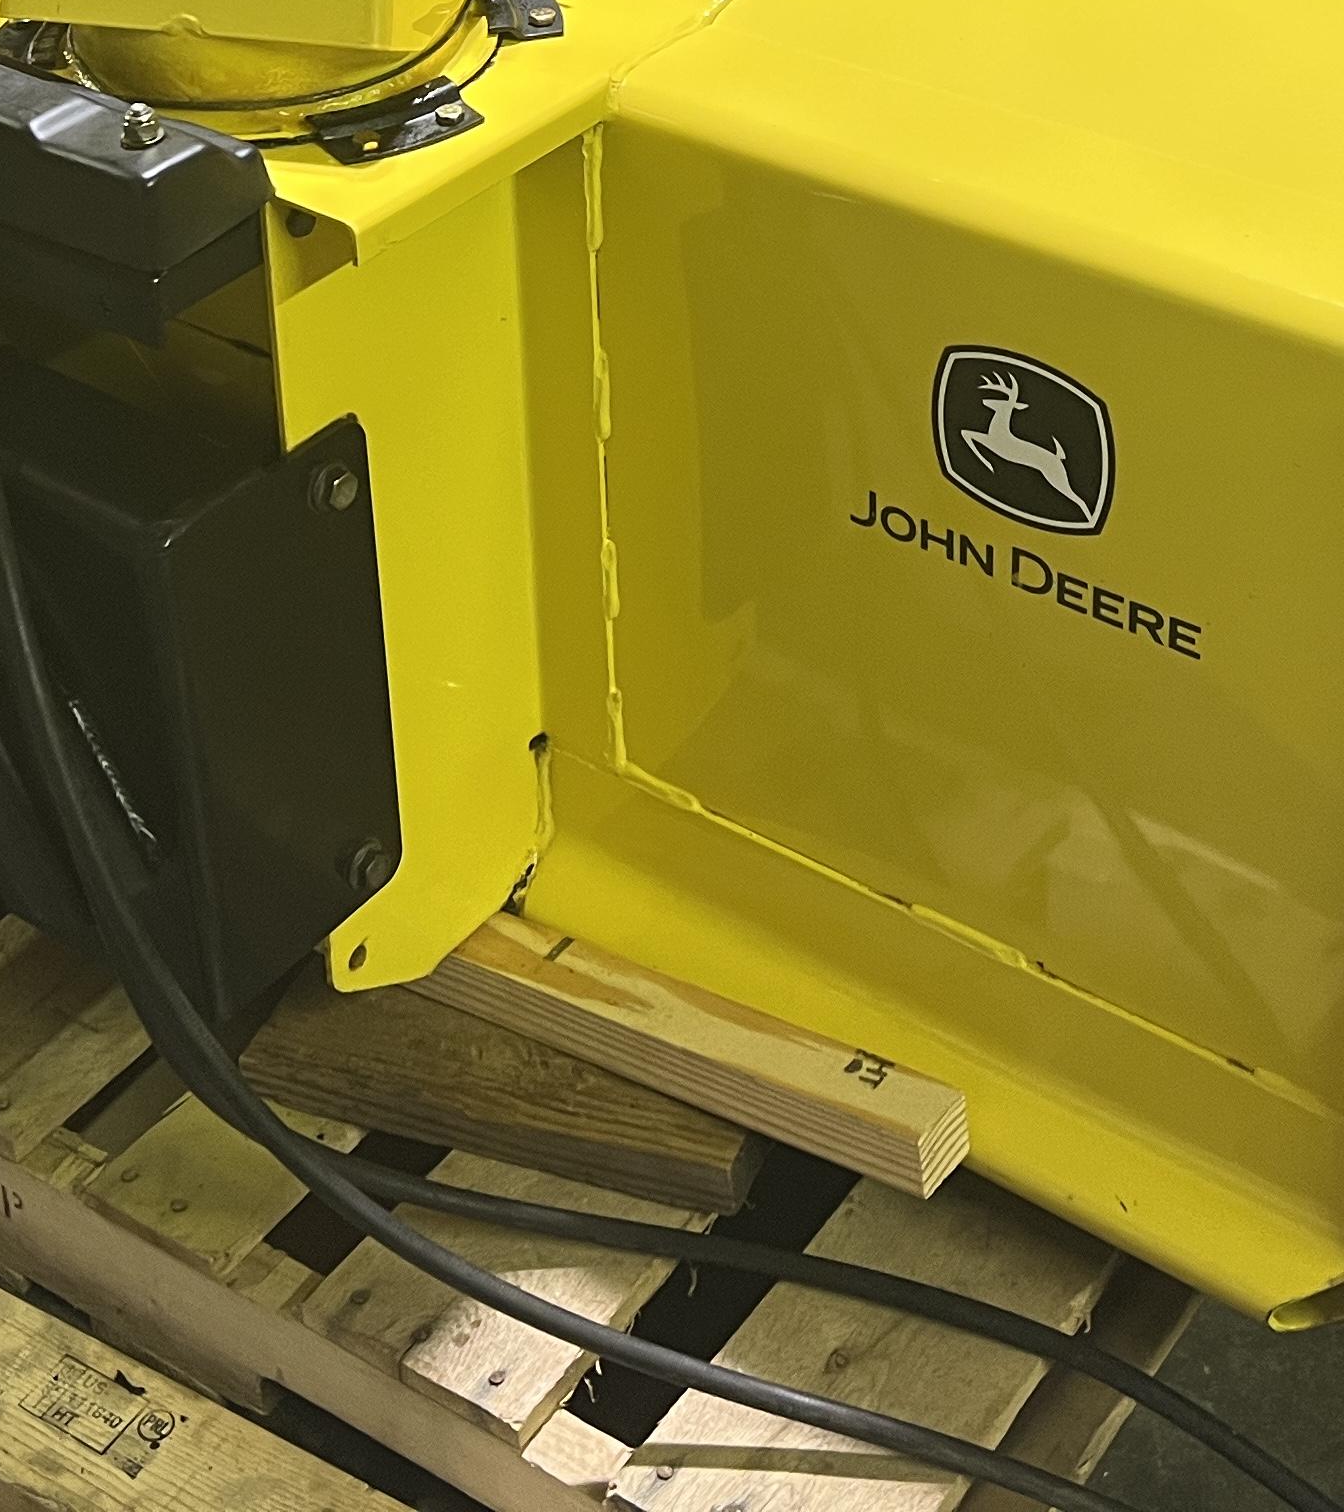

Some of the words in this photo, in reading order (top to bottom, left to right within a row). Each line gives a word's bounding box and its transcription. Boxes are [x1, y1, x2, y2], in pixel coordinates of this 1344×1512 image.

[850, 490, 994, 578] JOHN
[1011, 546, 1202, 660] DEERE
[51, 1406, 79, 1427] HT
